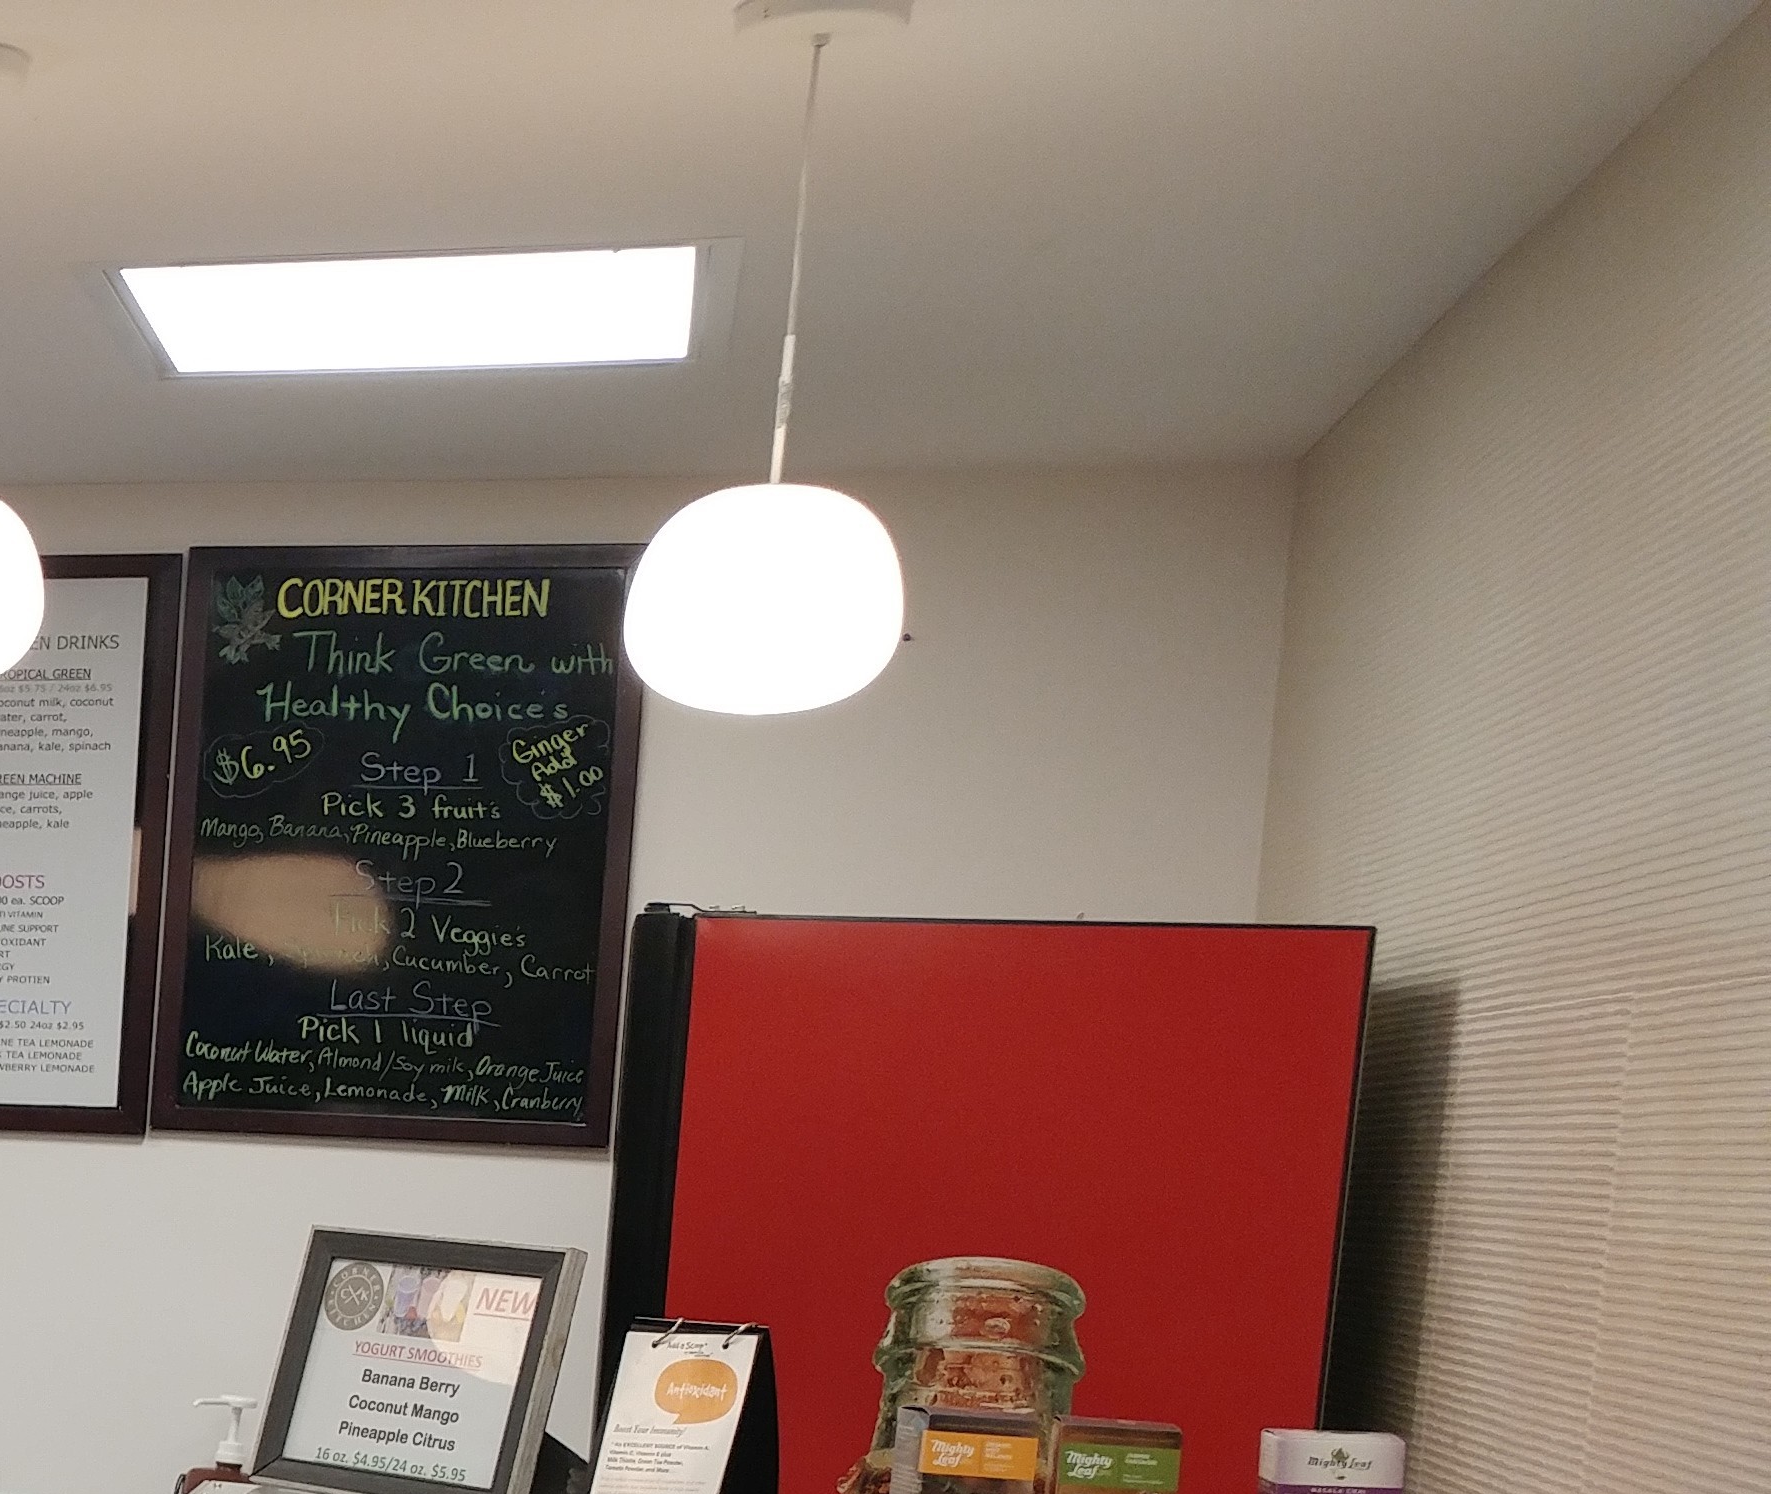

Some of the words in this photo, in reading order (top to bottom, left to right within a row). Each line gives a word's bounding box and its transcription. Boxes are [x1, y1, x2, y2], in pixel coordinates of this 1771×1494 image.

[277, 578, 406, 618] CORNER
[413, 578, 551, 619] KITCHEN
[57, 635, 120, 649] DRINKS
[293, 630, 395, 676] Think
[419, 632, 535, 674] Green
[551, 642, 614, 676] with
[256, 683, 411, 744] Healthy
[213, 729, 311, 786] $6.95
[512, 723, 590, 764] Ginger
[29, 774, 82, 785] MACHINE
[360, 752, 441, 794] Step
[463, 753, 478, 781] 1
[531, 747, 583, 781] Add
[540, 765, 604, 808] $1.00
[322, 793, 384, 818] Pick
[398, 795, 416, 818] 3
[355, 859, 436, 908] Step
[445, 862, 464, 894] 2
[29, 896, 64, 905] SCOOP
[331, 979, 396, 1011] Last
[413, 981, 493, 1033] Step
[297, 1015, 359, 1045] Pick
[402, 1019, 475, 1058] liquid
[476, 1288, 536, 1314] NEW
[354, 1341, 405, 1360] YOGURT
[407, 1347, 483, 1368] SMOOTHIES
[362, 1369, 414, 1389] Banana
[419, 1376, 460, 1398] Berry
[666, 1382, 728, 1401] Antioxidant
[348, 1394, 409, 1416] Coconut
[411, 1403, 459, 1425] Mango
[338, 1420, 408, 1445] Pineapple
[412, 1432, 456, 1451] Citrus
[931, 1439, 975, 1457] Mighty
[315, 1447, 330, 1461] 16
[332, 1452, 349, 1464] oz.
[353, 1451, 407, 1474] $4.95/24
[410, 1465, 426, 1477] oz.
[431, 1463, 466, 1482] $5.95
[933, 1453, 961, 1467] Leaf
[1065, 1451, 1114, 1469] Mighty
[1068, 1465, 1098, 1479] Leaf
[1307, 1456, 1347, 1468] Mighty
